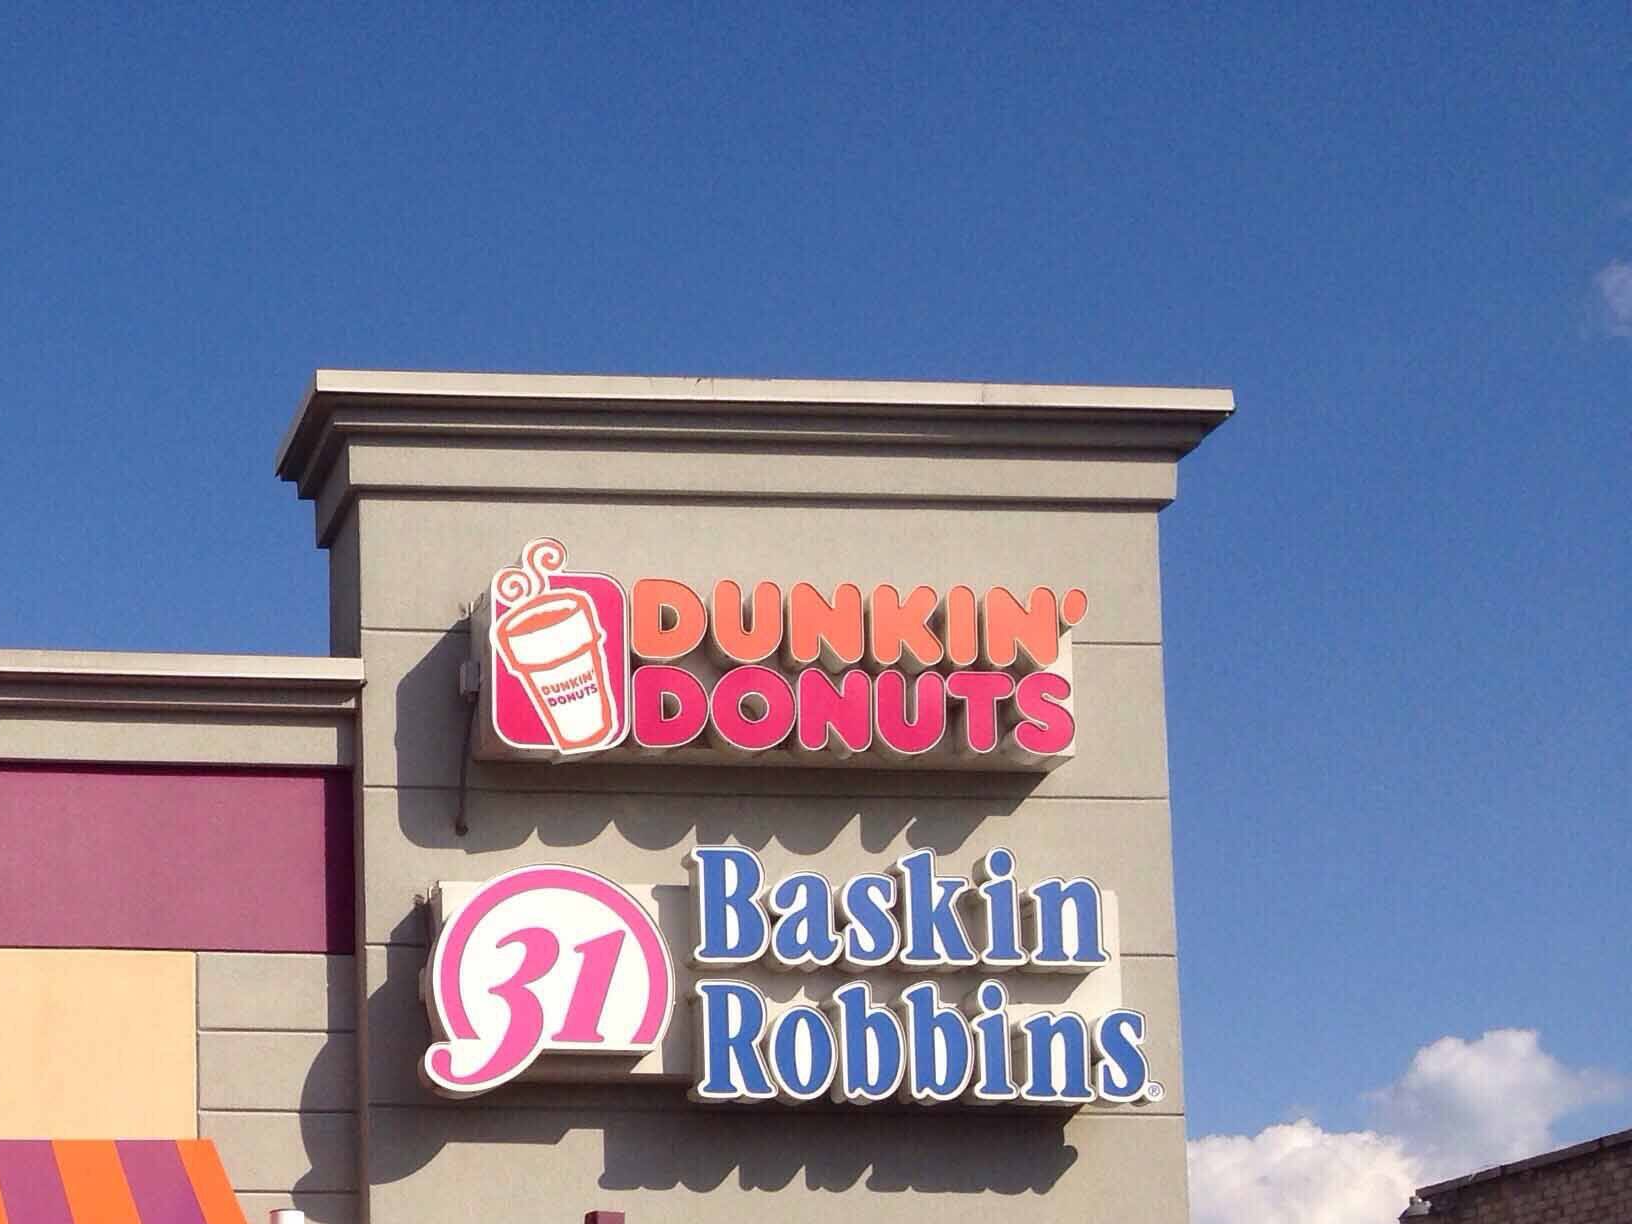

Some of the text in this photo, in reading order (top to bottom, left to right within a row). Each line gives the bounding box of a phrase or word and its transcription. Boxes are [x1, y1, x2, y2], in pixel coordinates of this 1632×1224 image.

[630, 578, 1088, 667] DUNKIN'
[542, 669, 594, 695] DUNKIN'
[548, 683, 598, 706] DONUTS
[630, 665, 1076, 754] DONUTS
[694, 847, 1107, 964] Baskin
[426, 926, 626, 1087] 31
[699, 980, 1148, 1099] Robbins
